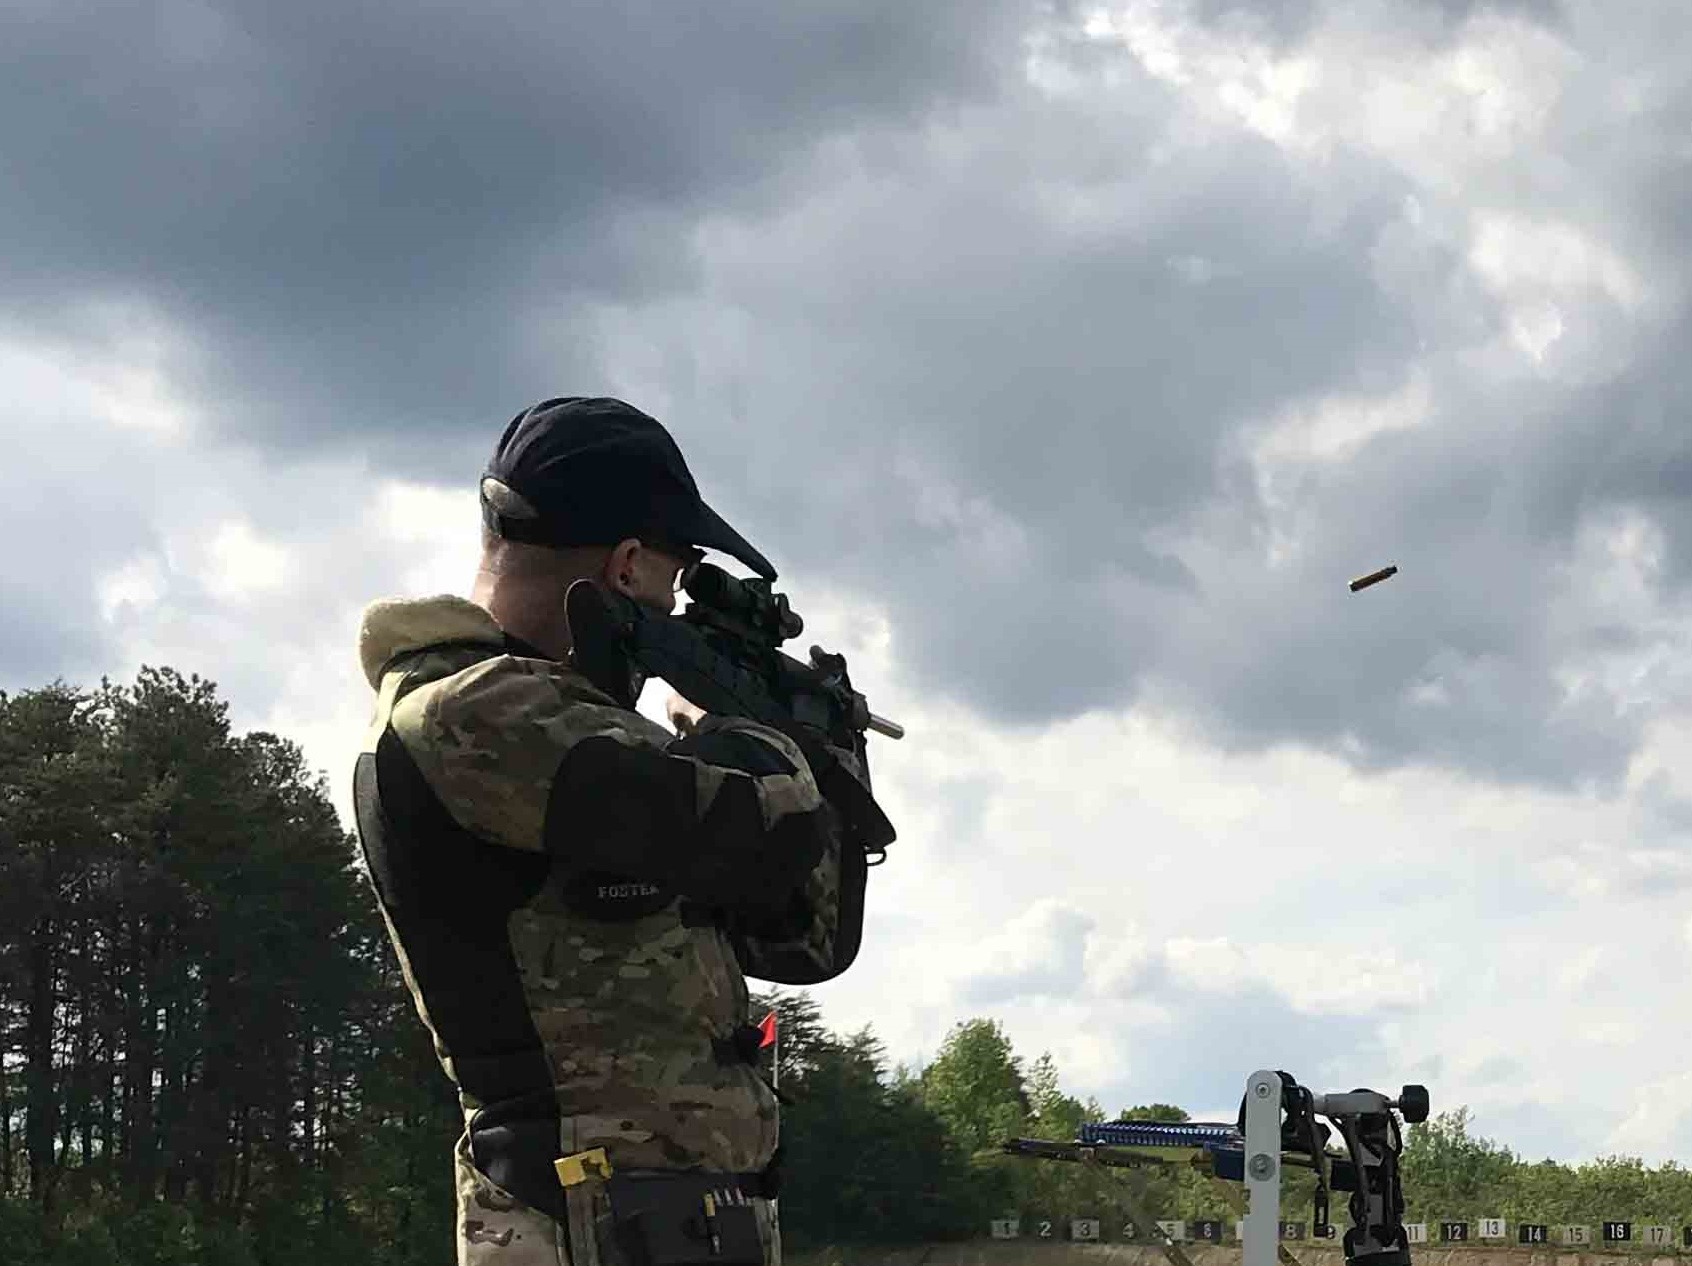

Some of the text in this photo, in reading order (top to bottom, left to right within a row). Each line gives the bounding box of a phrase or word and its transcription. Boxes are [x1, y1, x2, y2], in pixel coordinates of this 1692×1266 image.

[1039, 1221, 1051, 1237] 2
[1122, 1222, 1135, 1238] 4
[1285, 1224, 1297, 1239] 8
[1408, 1225, 1419, 1240] 11
[1446, 1224, 1461, 1240] 12
[1485, 1220, 1498, 1235] 13
[1527, 1226, 1541, 1241] 14
[1568, 1227, 1583, 1242] 15
[1610, 1223, 1624, 1239] 16
[1650, 1226, 1664, 1242] 17
